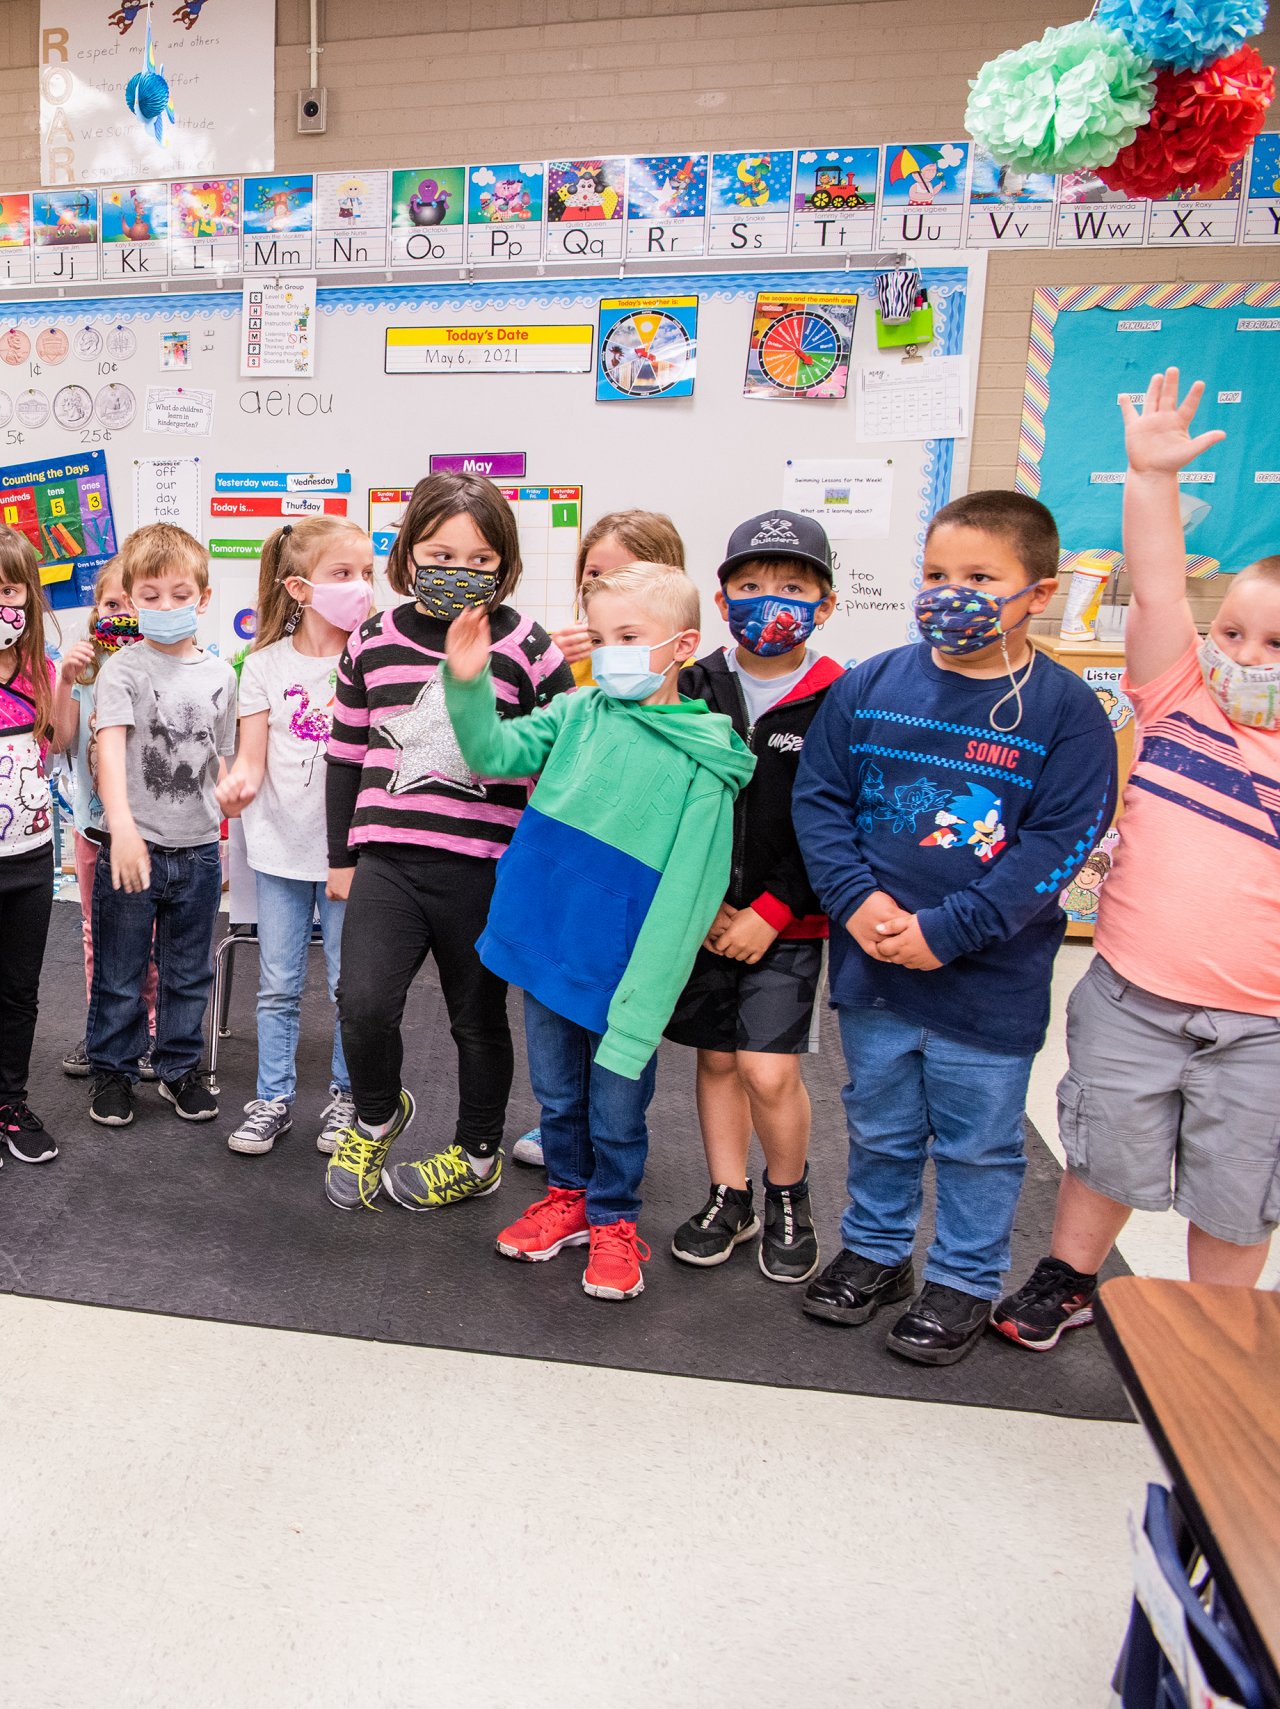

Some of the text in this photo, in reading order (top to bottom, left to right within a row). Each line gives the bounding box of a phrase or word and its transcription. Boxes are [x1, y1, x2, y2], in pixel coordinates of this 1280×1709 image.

[191, 36, 220, 47] others
[1074, 212, 1131, 239] Ww
[1170, 210, 1213, 237] Xx
[491, 230, 522, 260] Pp
[563, 229, 604, 257] Qq
[648, 226, 678, 252] Rr
[334, 238, 367, 262] Nn
[407, 234, 445, 259] Oo
[255, 241, 300, 265] Mm
[122, 249, 149, 272] Kk
[1119, 321, 1160, 329] JANUARY
[446, 329, 529, 342] Today's Date
[426, 349, 453, 367] May
[484, 348, 518, 363] 2021
[1219, 392, 1239, 401] MAY
[180, 405, 203, 413] children
[168, 412, 182, 420] learn
[158, 419, 198, 428] kindergarten?
[156, 467, 176, 476] off
[463, 460, 493, 474] May
[2, 464, 89, 486] Counting the Days
[1178, 473, 1214, 482] TEMBER
[1257, 473, 1280, 482] OCTO
[81, 482, 100, 491] ones
[218, 478, 259, 488] Yesterday
[292, 477, 334, 487] Wednesday
[47, 487, 64, 496] tens
[91, 496, 100, 508] 3
[157, 493, 177, 505] day
[55, 502, 63, 514] 5
[154, 506, 180, 516] take
[213, 502, 320, 513] Today is... Thursday
[381, 538, 388, 550] 2
[751, 537, 800, 546] Builders
[211, 545, 252, 553] Tomorrow
[849, 569, 874, 581] too
[846, 600, 905, 616] phonemes
[964, 740, 1020, 769] SONIC
